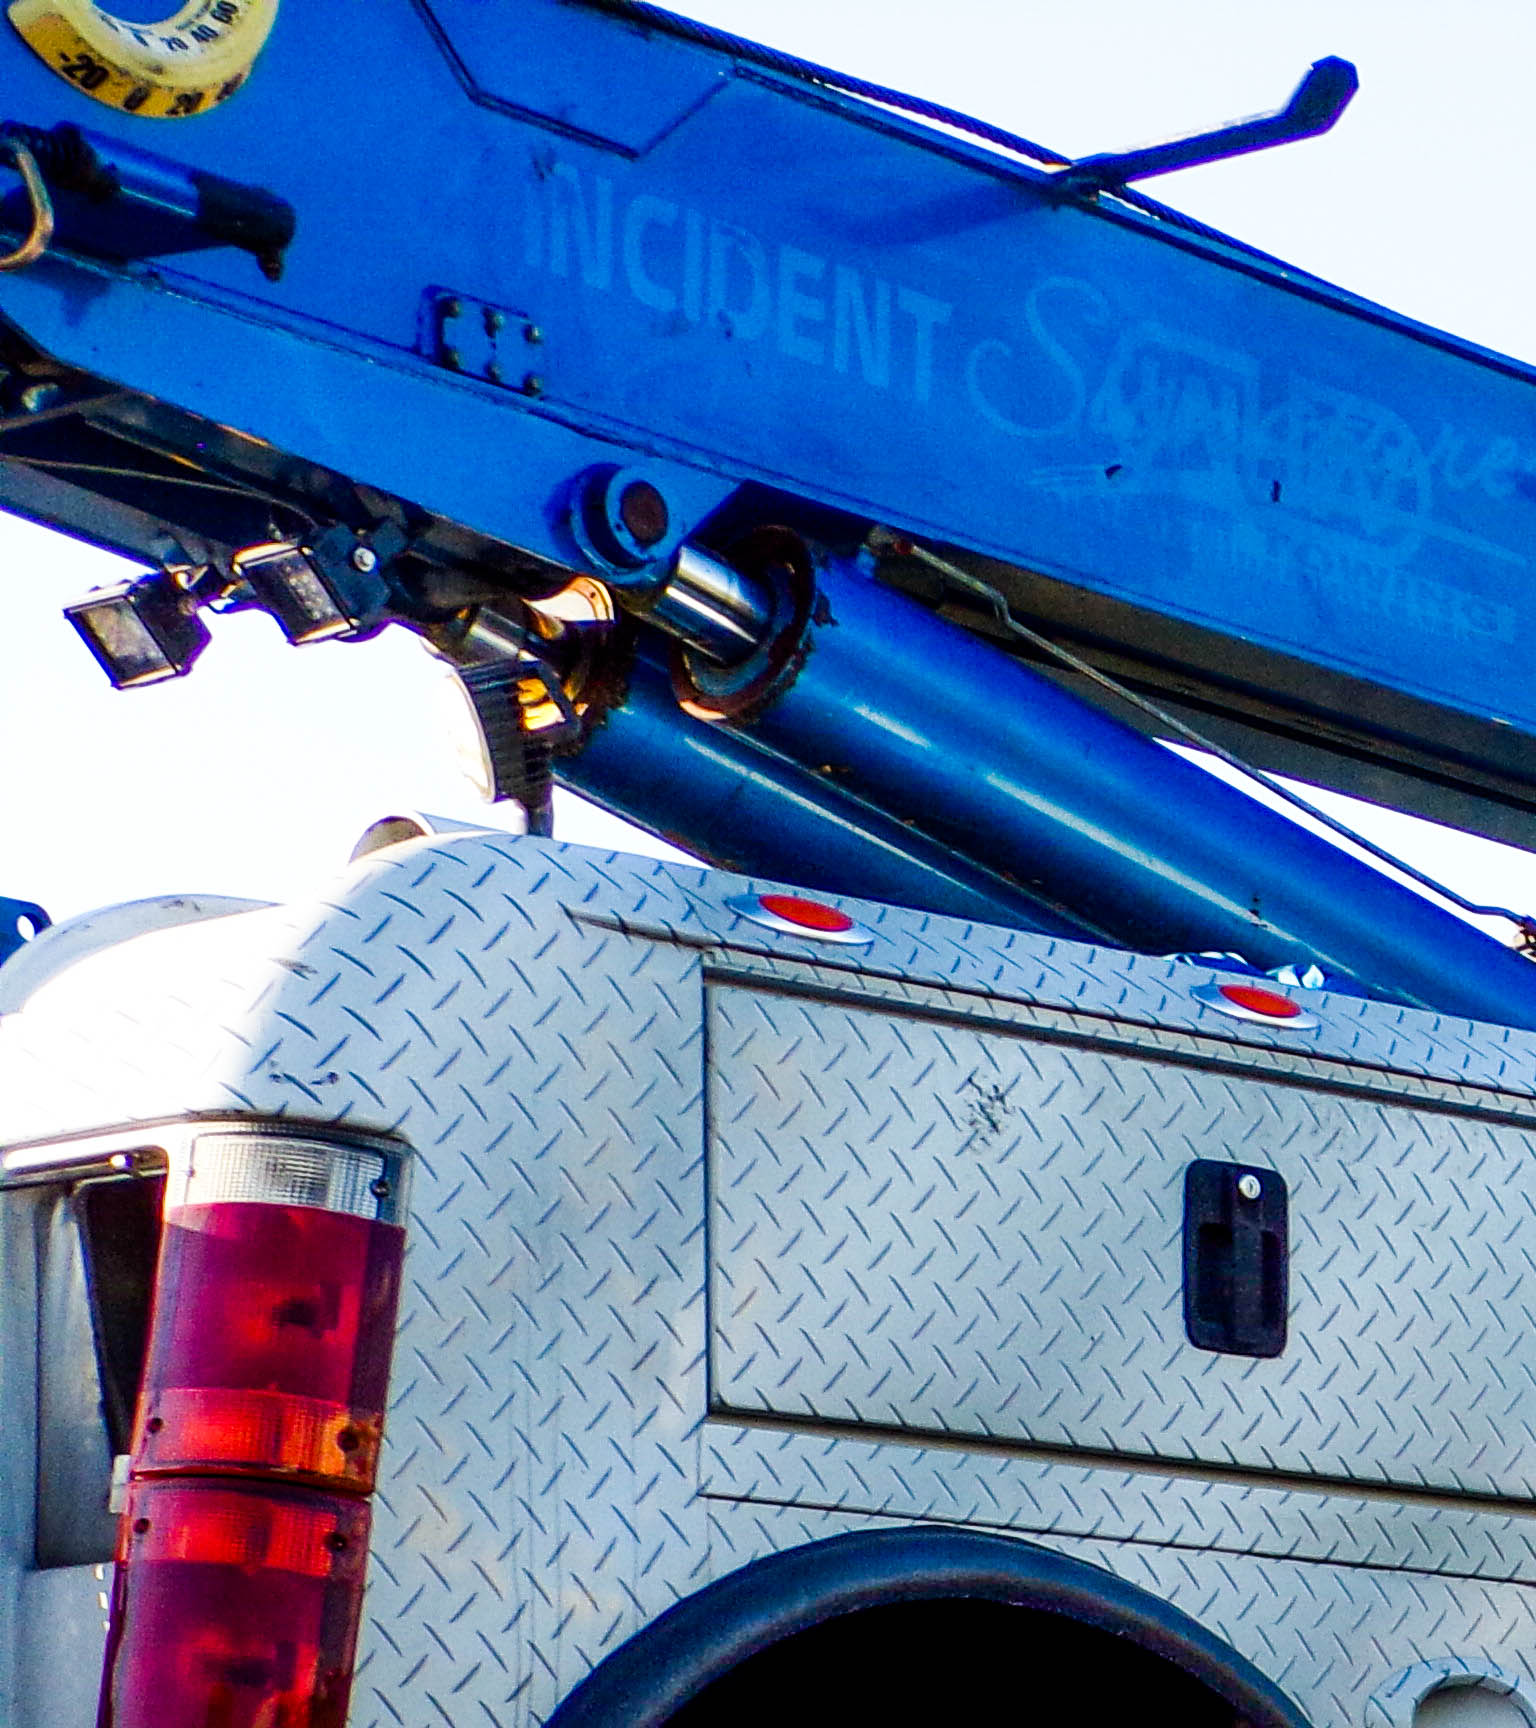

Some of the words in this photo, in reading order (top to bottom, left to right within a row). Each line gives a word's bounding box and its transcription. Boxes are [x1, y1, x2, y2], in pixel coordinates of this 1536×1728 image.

[209, 0, 239, 25] 60
[59, 52, 110, 90] -20
[524, 160, 953, 406] INCIDENT
